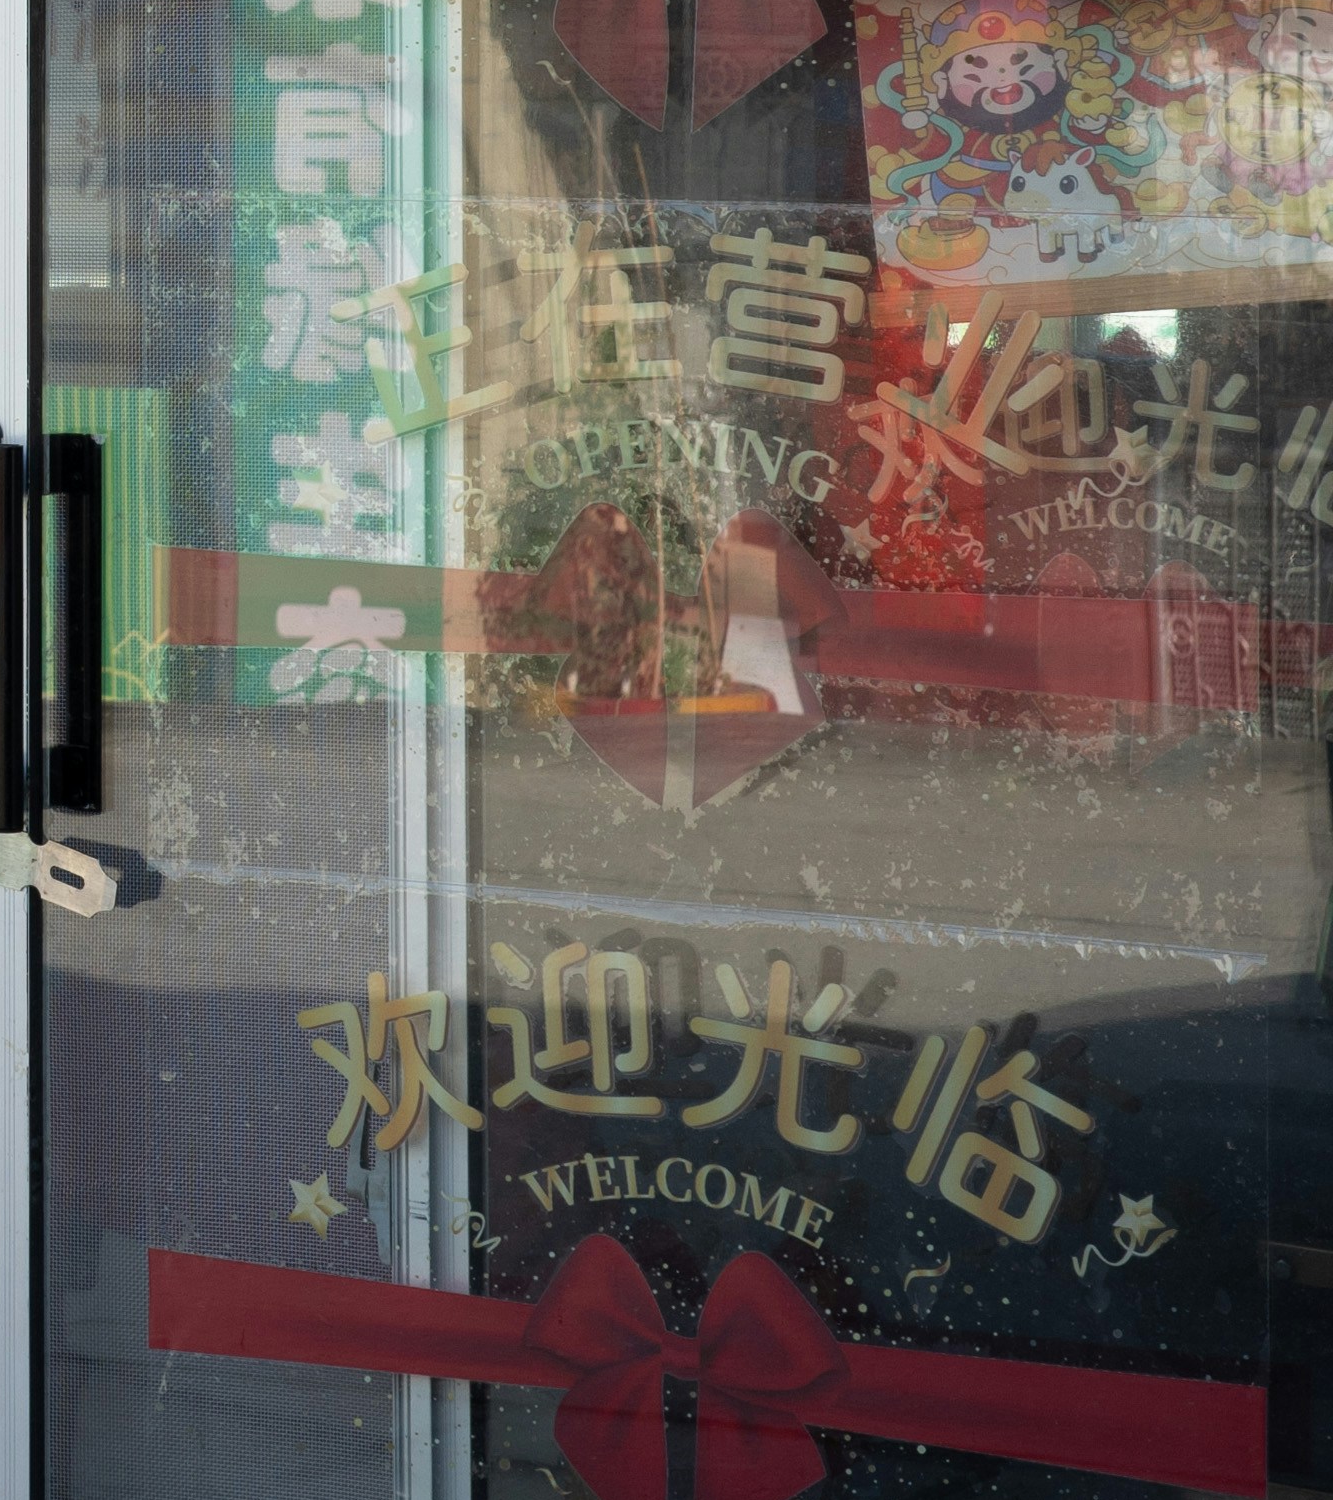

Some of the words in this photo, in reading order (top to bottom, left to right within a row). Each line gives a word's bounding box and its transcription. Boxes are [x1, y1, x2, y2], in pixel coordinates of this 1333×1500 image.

[329, 222, 1067, 476] 正在营业
[521, 416, 840, 505] OPENING
[1007, 496, 1239, 557] WELCOME
[297, 940, 1097, 1244] 欢迎光临
[520, 1154, 836, 1251] WELCOME
